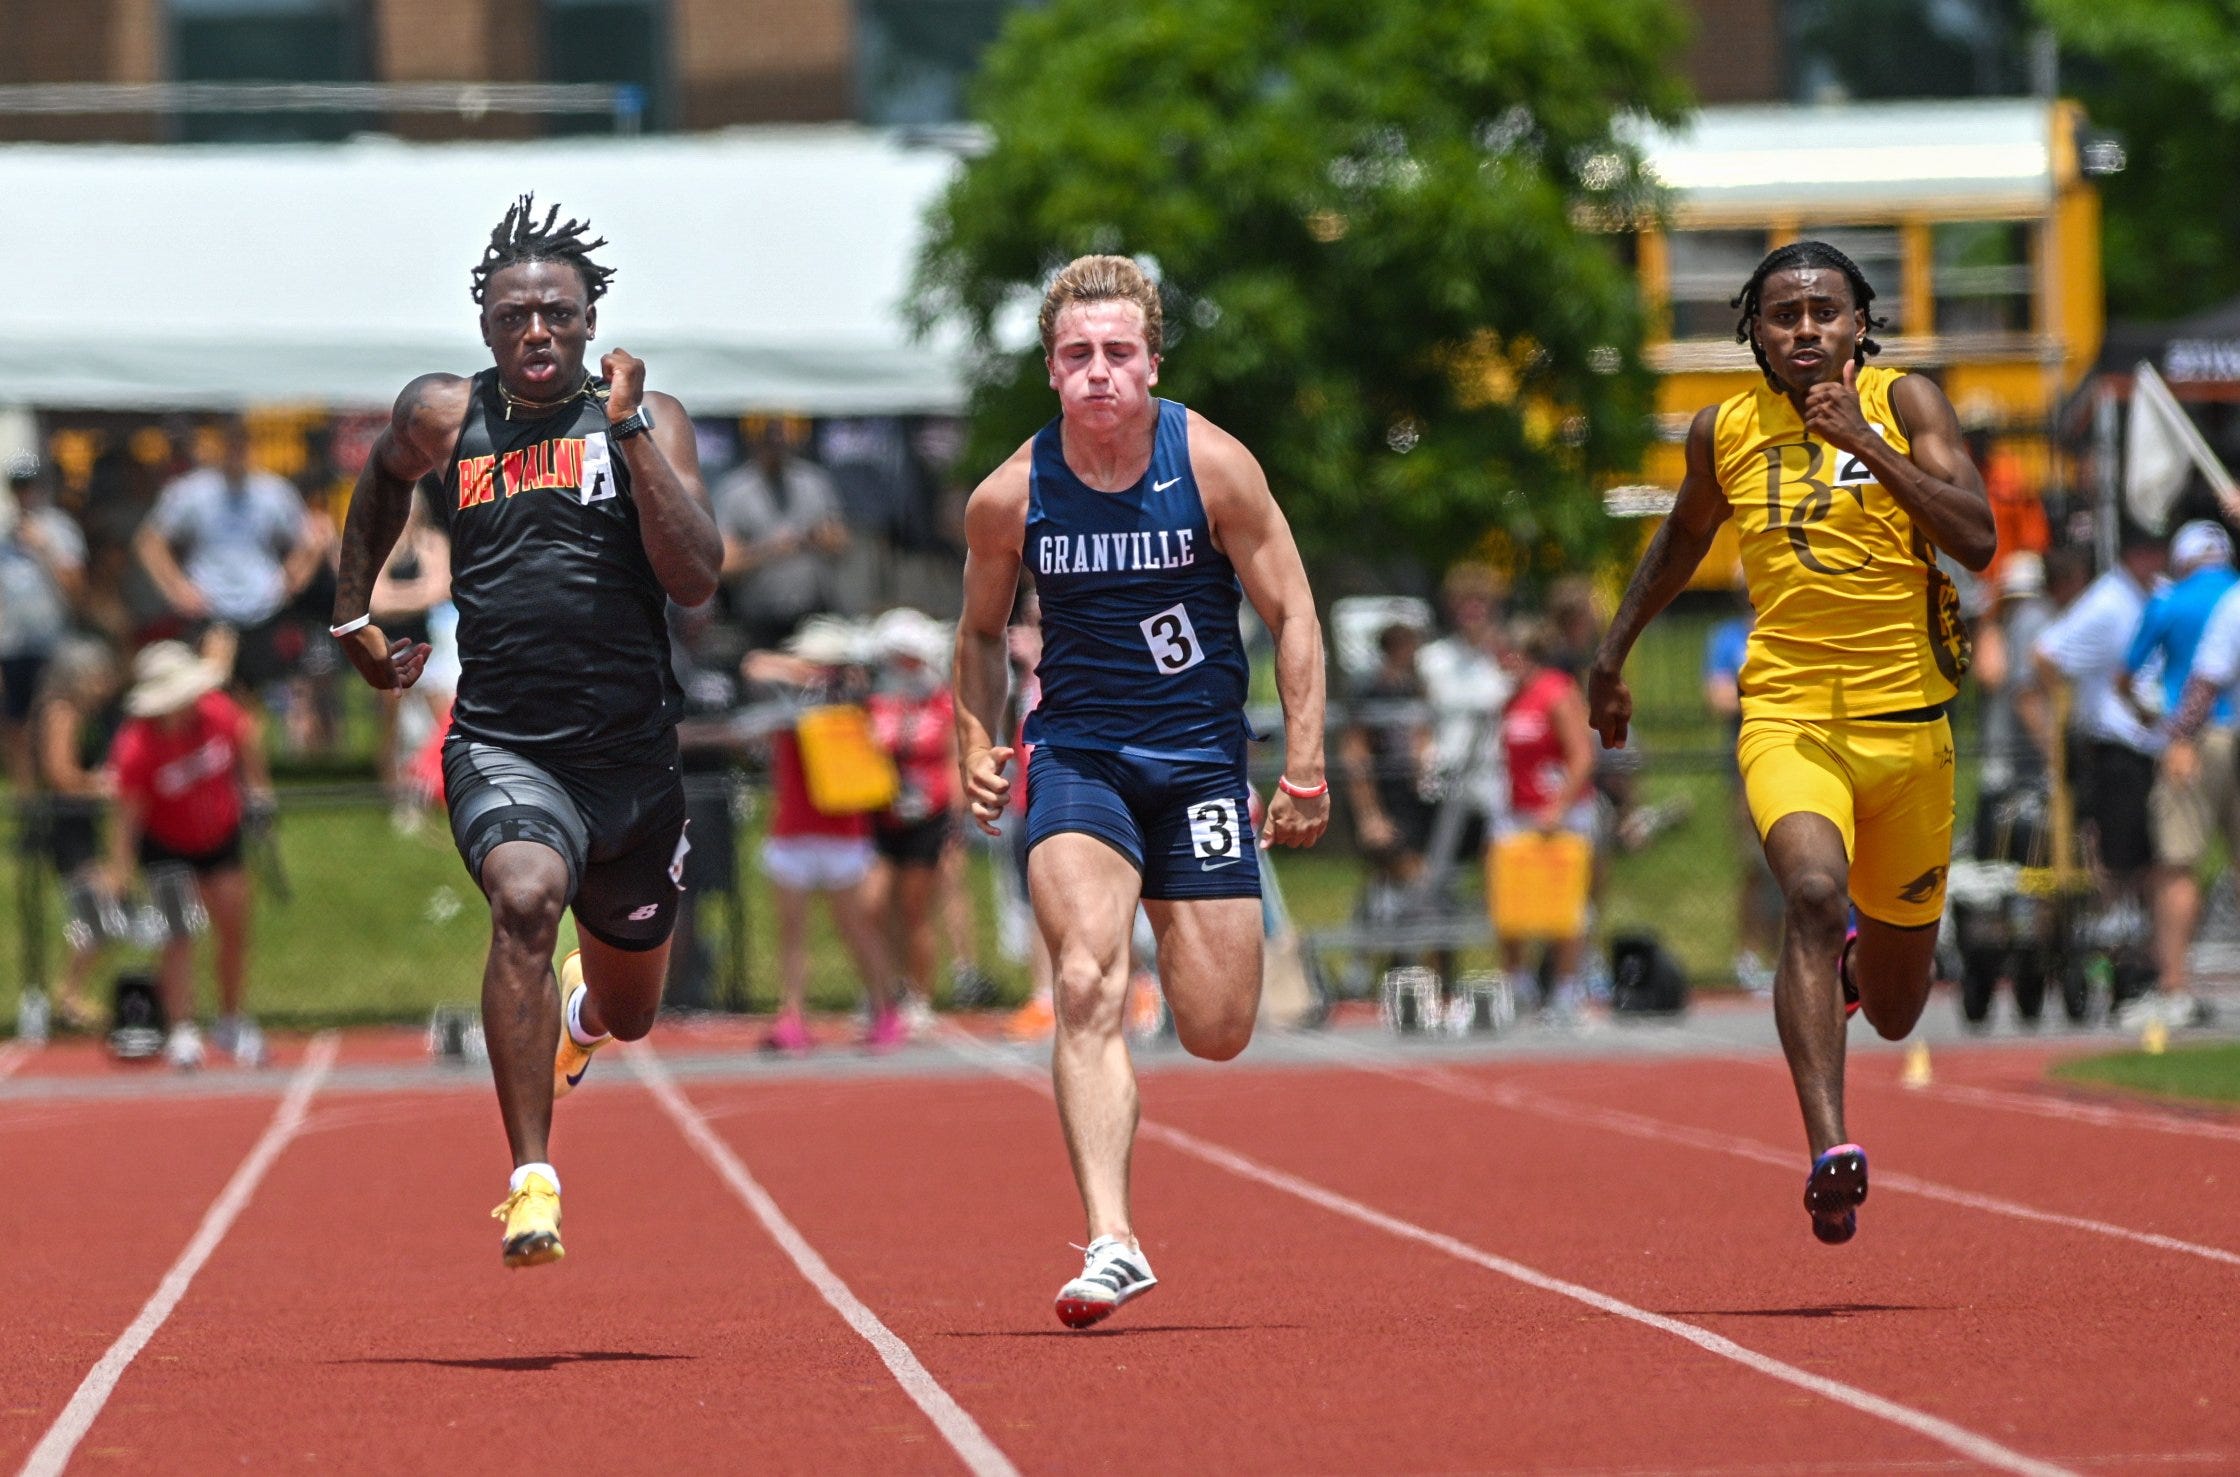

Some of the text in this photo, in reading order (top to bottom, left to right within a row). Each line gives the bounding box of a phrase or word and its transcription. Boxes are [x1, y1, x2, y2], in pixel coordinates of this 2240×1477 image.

[1039, 528, 1195, 575] GRANVILLE
[1151, 614, 1193, 669] 3
[1197, 804, 1232, 857] 3
